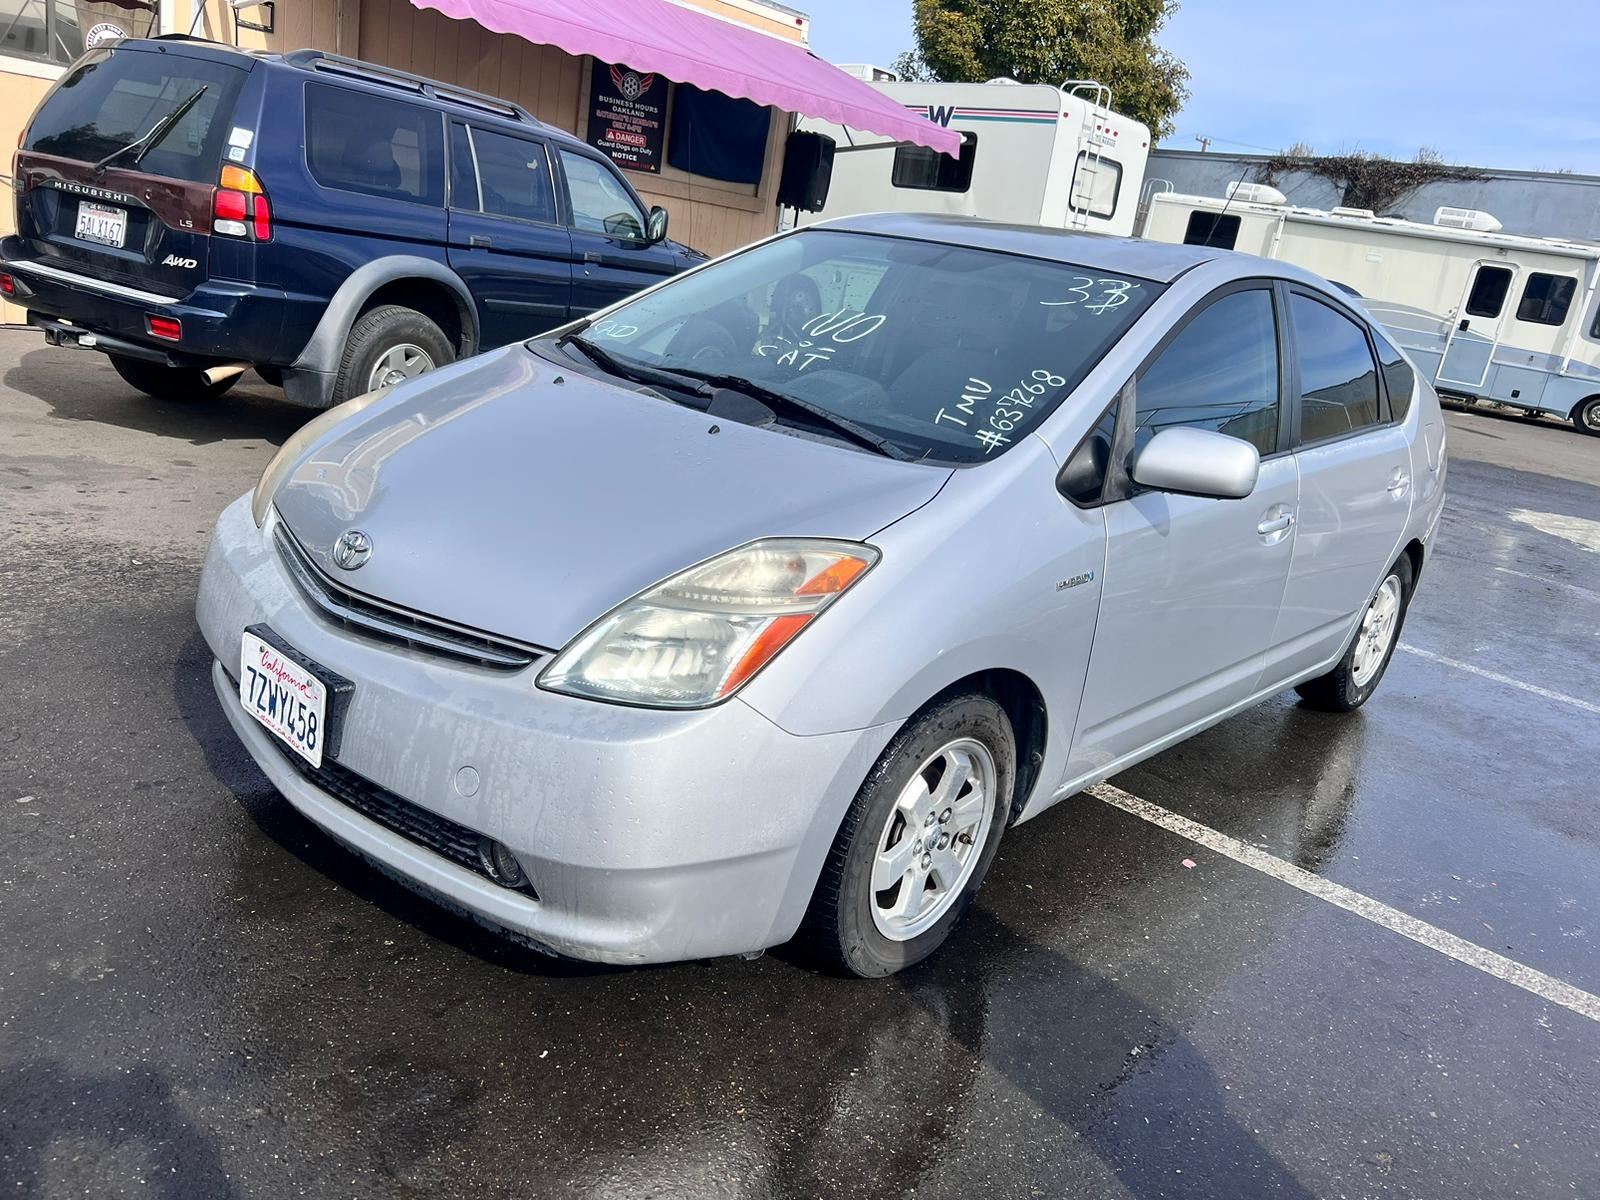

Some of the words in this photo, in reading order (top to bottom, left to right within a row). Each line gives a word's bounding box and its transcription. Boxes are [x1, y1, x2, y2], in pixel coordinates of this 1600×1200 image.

[598, 95, 634, 108] BUSINESS
[635, 103, 658, 113] HOURS
[612, 105, 645, 117] OAKLAND
[597, 139, 616, 148] Guard
[616, 143, 631, 152] Dogs
[640, 147, 653, 156] Duty
[615, 133, 645, 145] DANGER
[612, 151, 638, 161] NOTICE
[54, 181, 128, 202] MITSUBISHI
[79, 215, 122, 241] 5ALX167
[179, 219, 193, 228] LS
[161, 254, 198, 269] AWD
[801, 307, 887, 343] NO
[758, 344, 831, 371] CAT
[974, 369, 1066, 455] #637268
[260, 650, 312, 699] California
[246, 665, 318, 751] 7ZWY458
